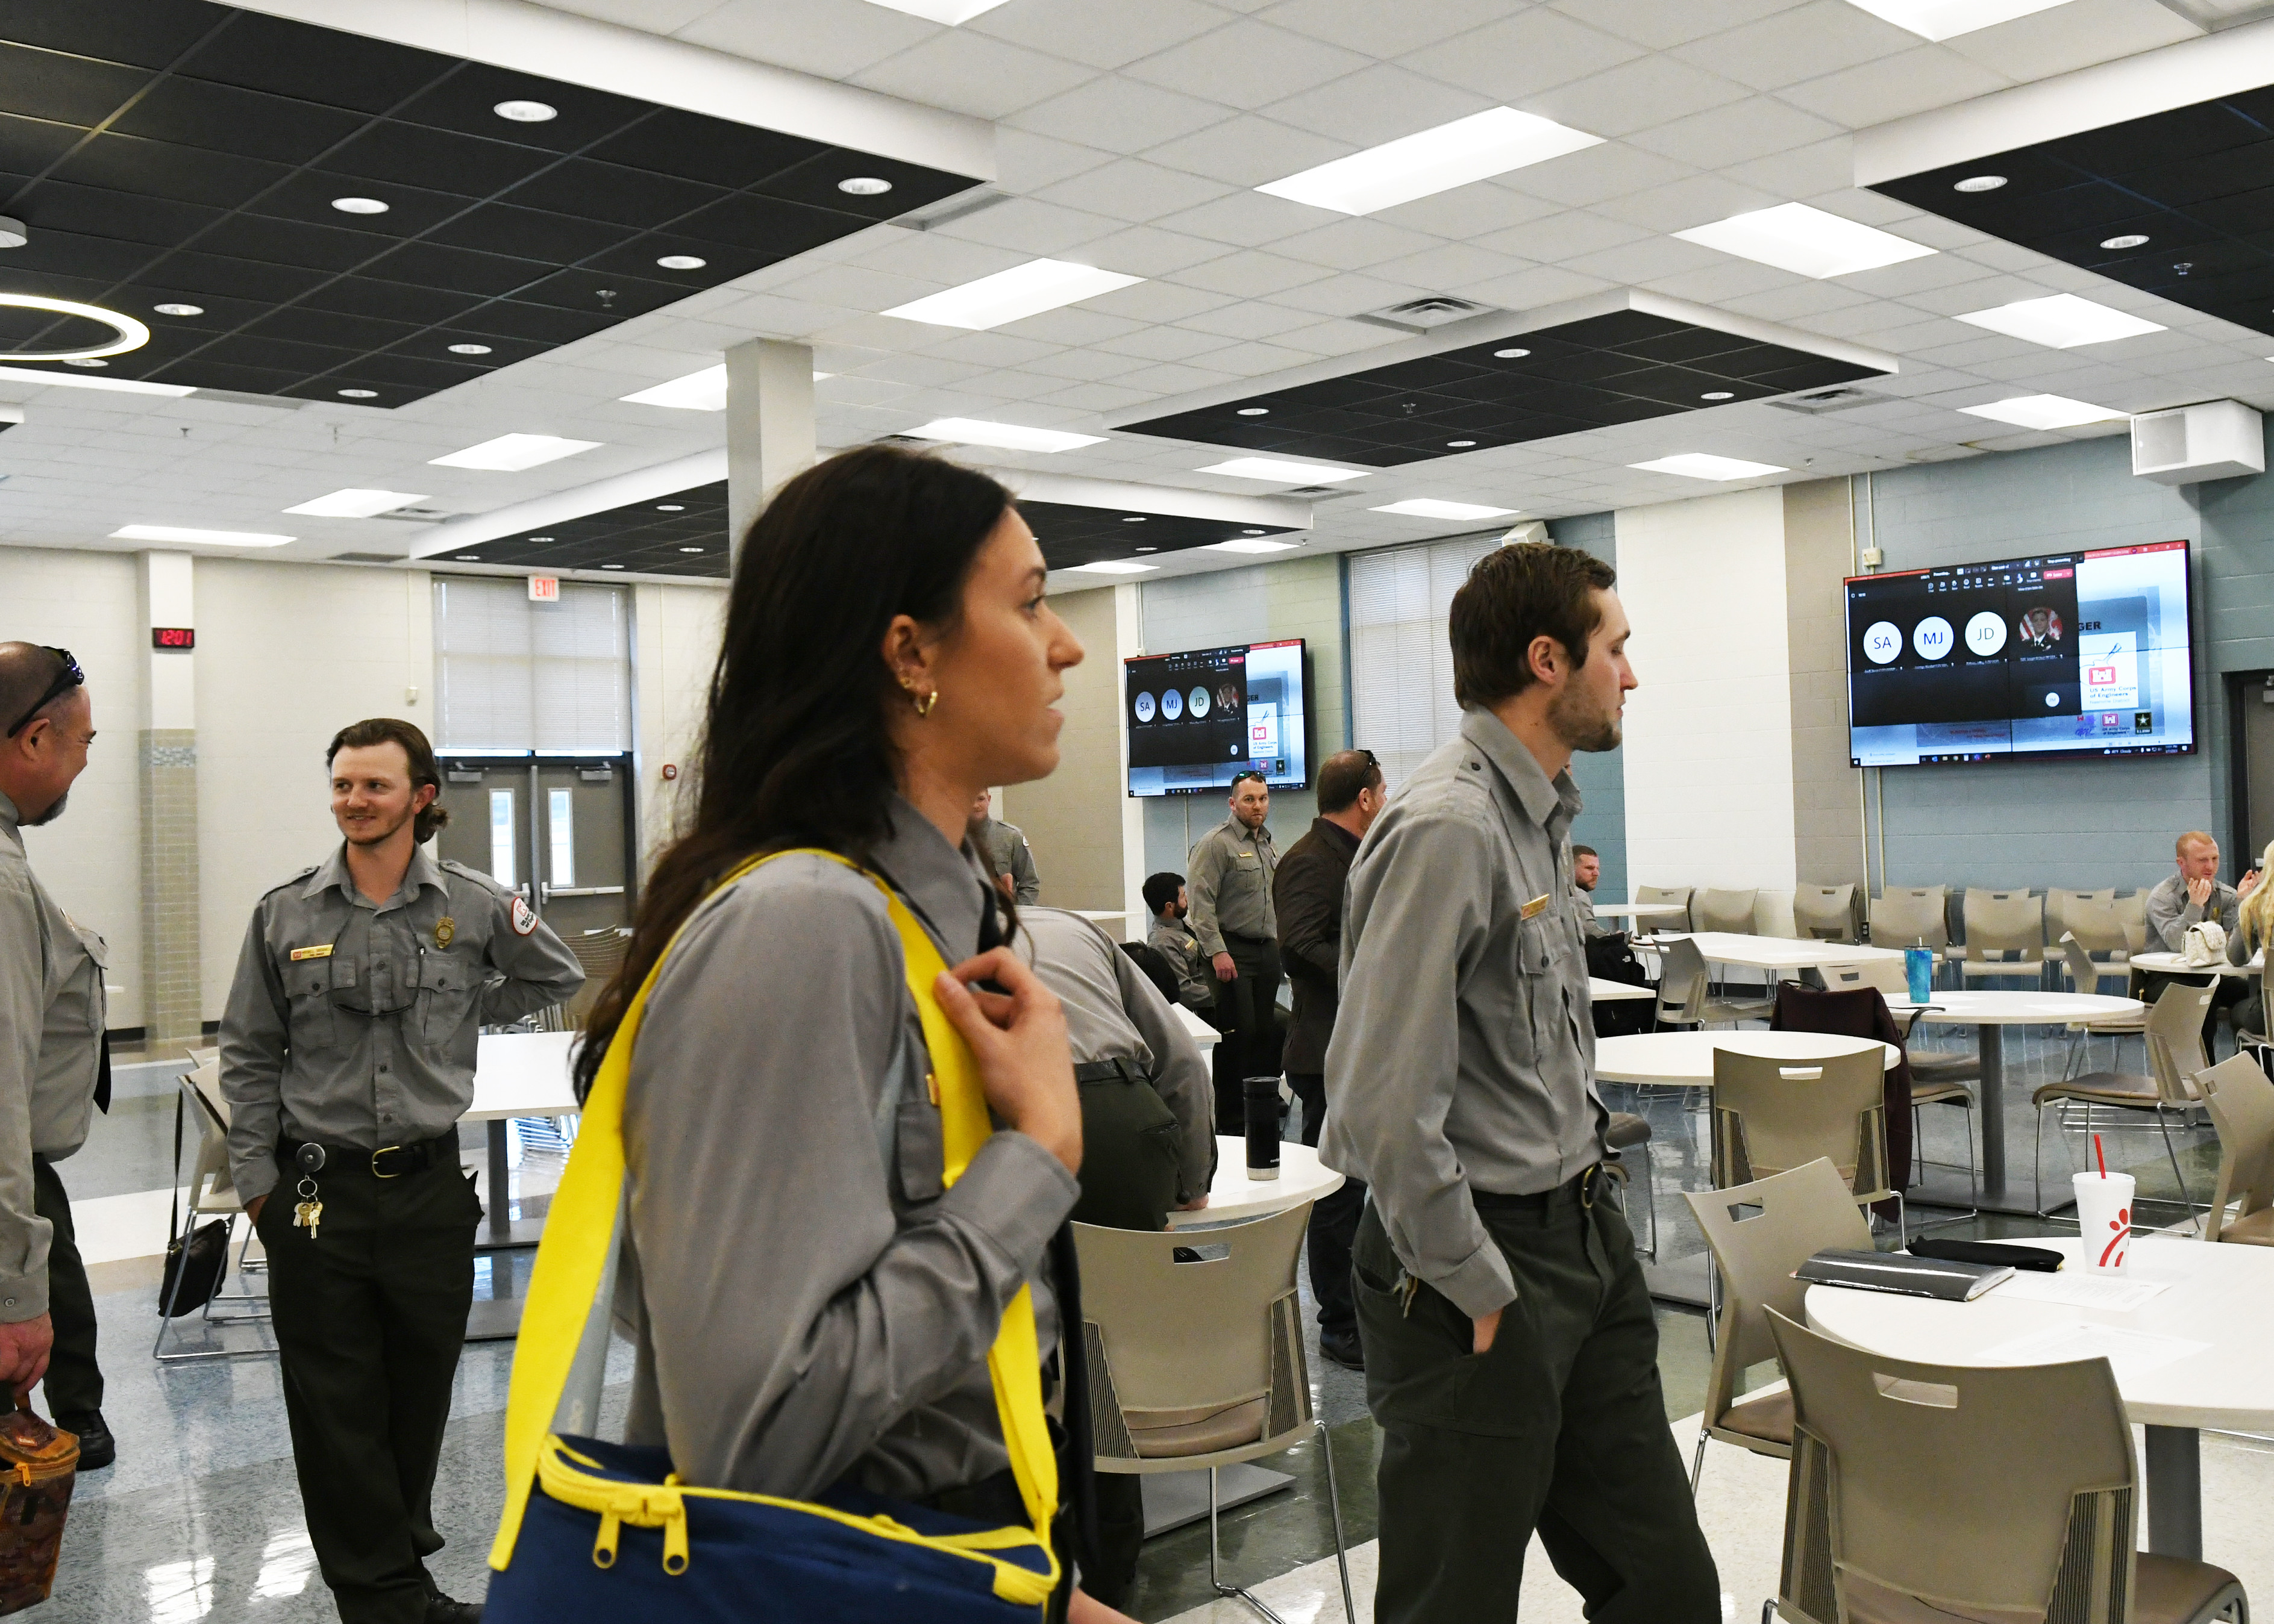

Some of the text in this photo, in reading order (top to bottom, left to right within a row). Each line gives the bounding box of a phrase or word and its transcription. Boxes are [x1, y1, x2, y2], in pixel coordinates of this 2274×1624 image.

[534, 579, 556, 596] EXIT
[1923, 632, 1943, 645] MJ
[1977, 628, 1994, 640] JD
[1874, 637, 1891, 649] SA
[1140, 702, 1150, 711] SA
[1167, 699, 1177, 709] MJ
[1194, 697, 1204, 707] JD
